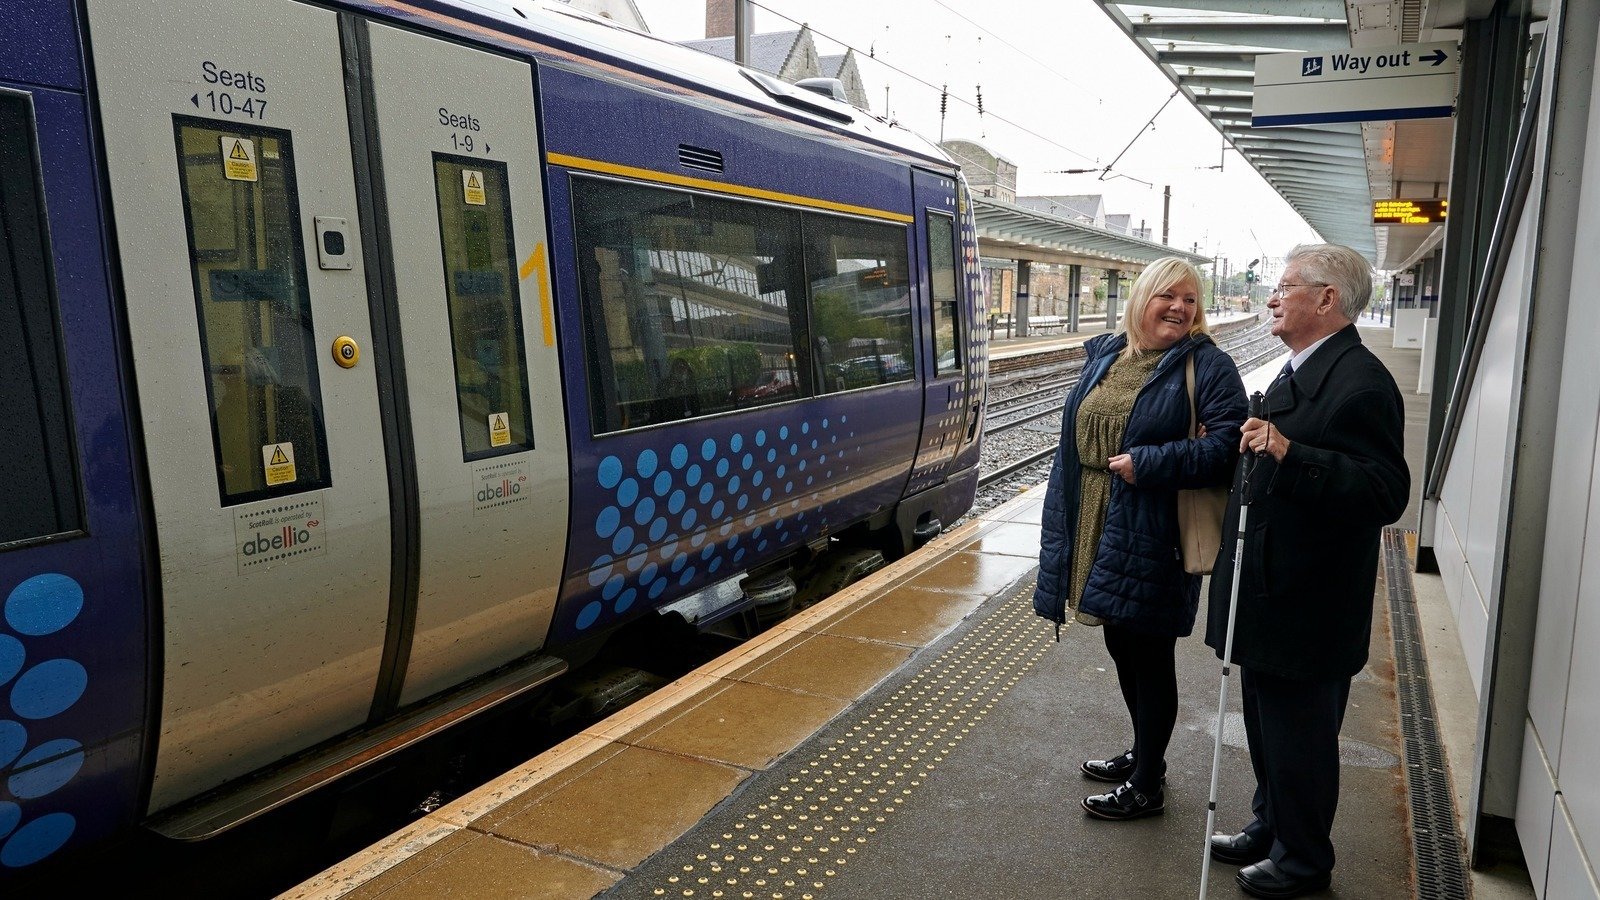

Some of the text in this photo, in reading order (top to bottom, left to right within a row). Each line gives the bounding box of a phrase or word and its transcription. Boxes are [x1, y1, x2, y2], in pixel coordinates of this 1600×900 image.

[1332, 50, 1411, 74] Way out
[202, 61, 266, 93] Seats
[206, 90, 267, 120] 10-47
[438, 107, 480, 132] Seats
[451, 133, 473, 152] 1-9
[520, 242, 554, 348] 1
[477, 479, 521, 502] abellio
[248, 509, 313, 530] ScotRail is operated by
[242, 525, 310, 556] abellio
